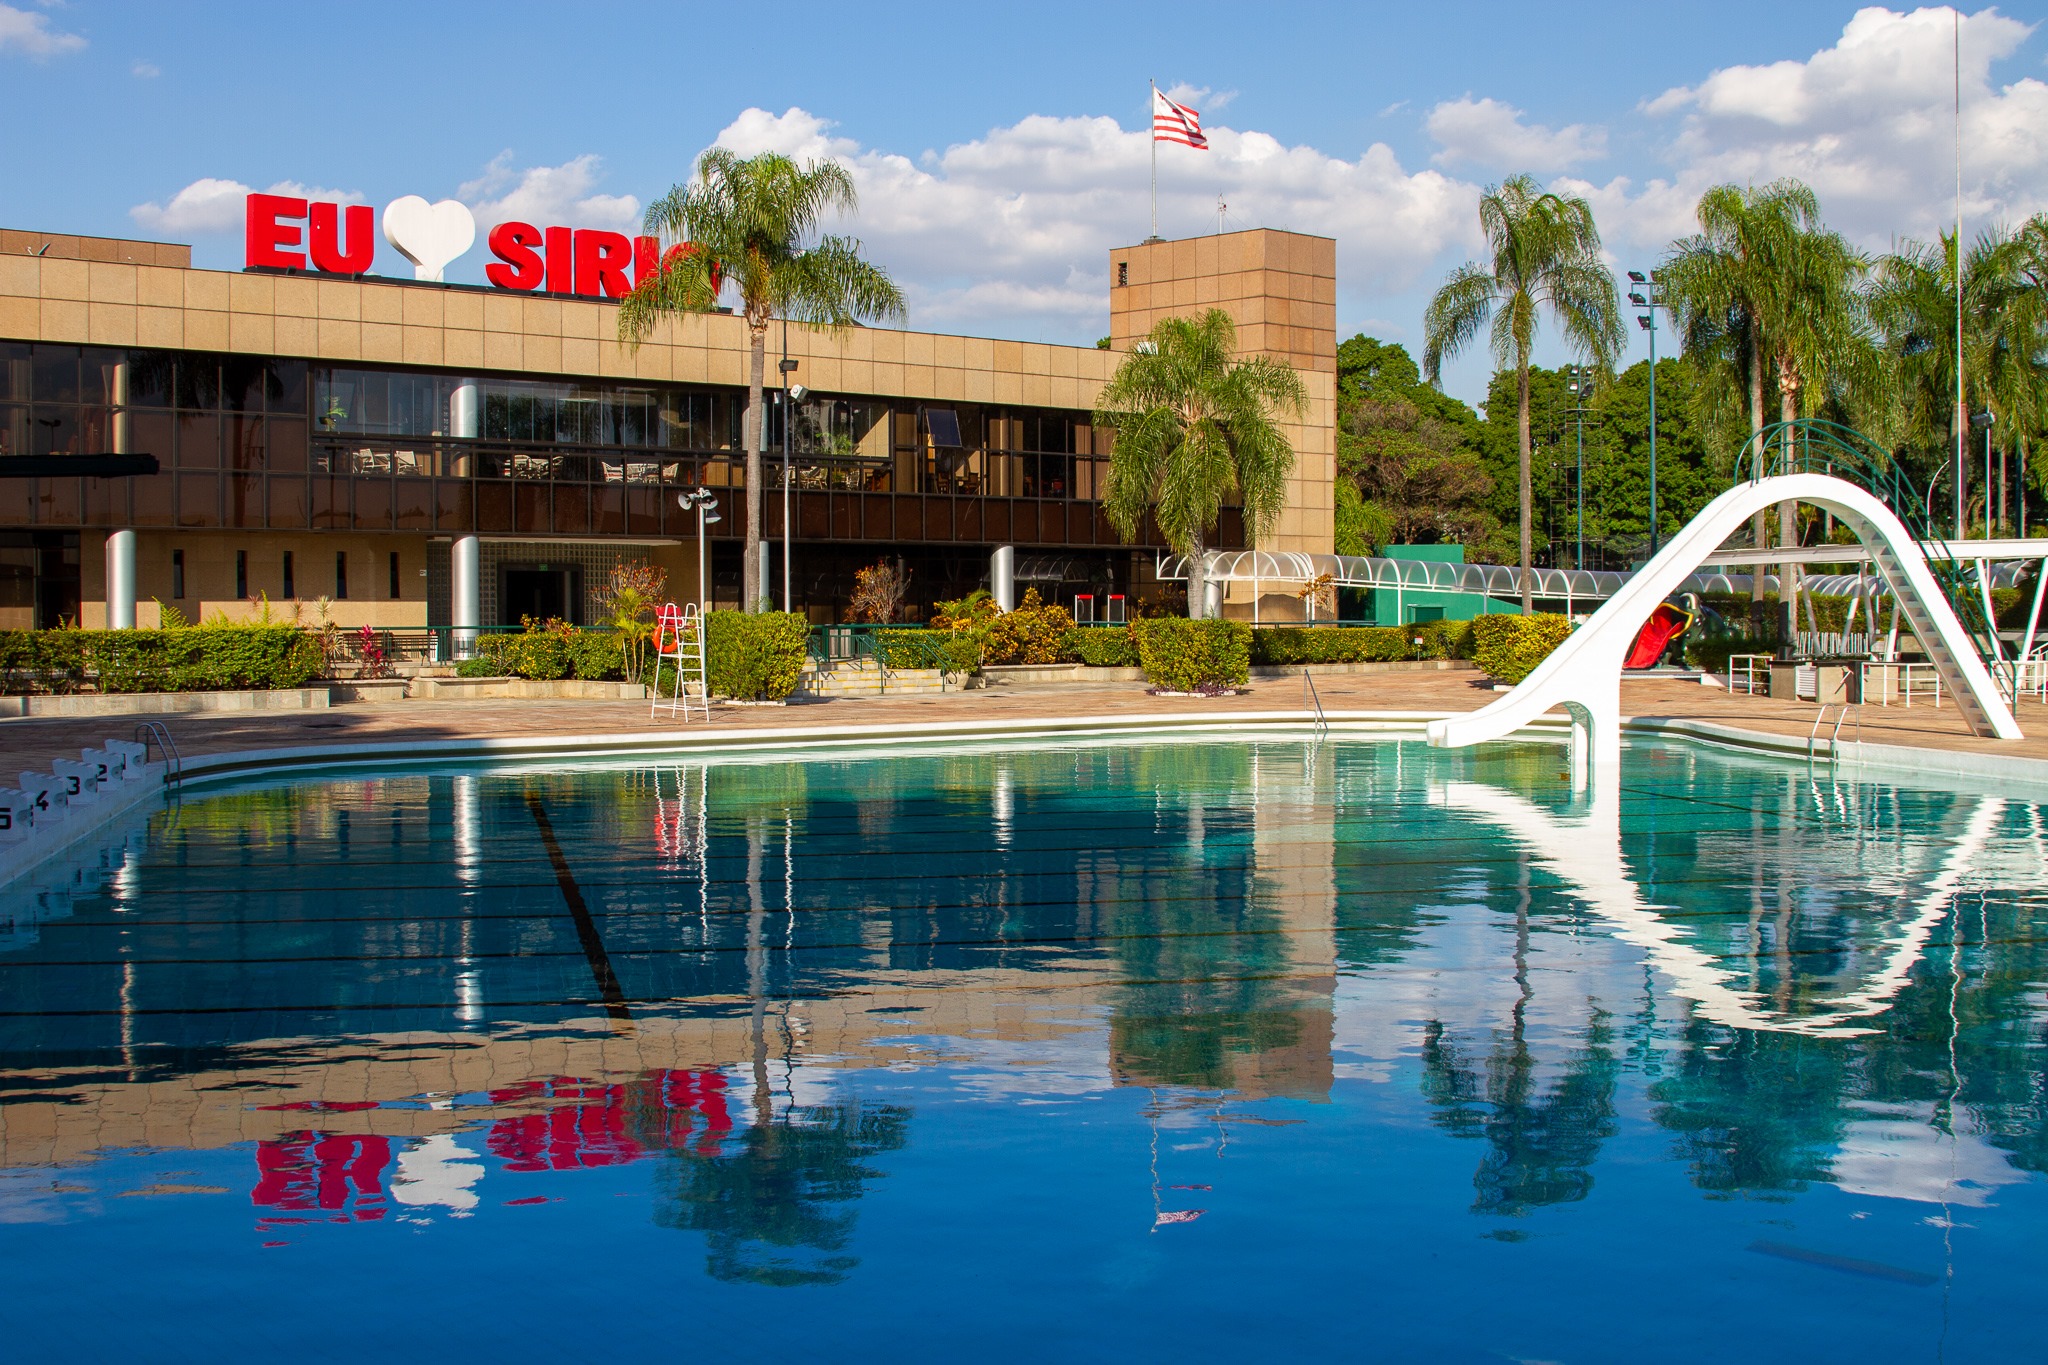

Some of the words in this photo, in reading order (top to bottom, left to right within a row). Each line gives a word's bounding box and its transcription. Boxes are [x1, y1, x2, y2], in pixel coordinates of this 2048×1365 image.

[246, 194, 374, 274] EU
[96, 764, 107, 782] 2
[67, 776, 80, 795] 3
[36, 791, 48, 811] 4
